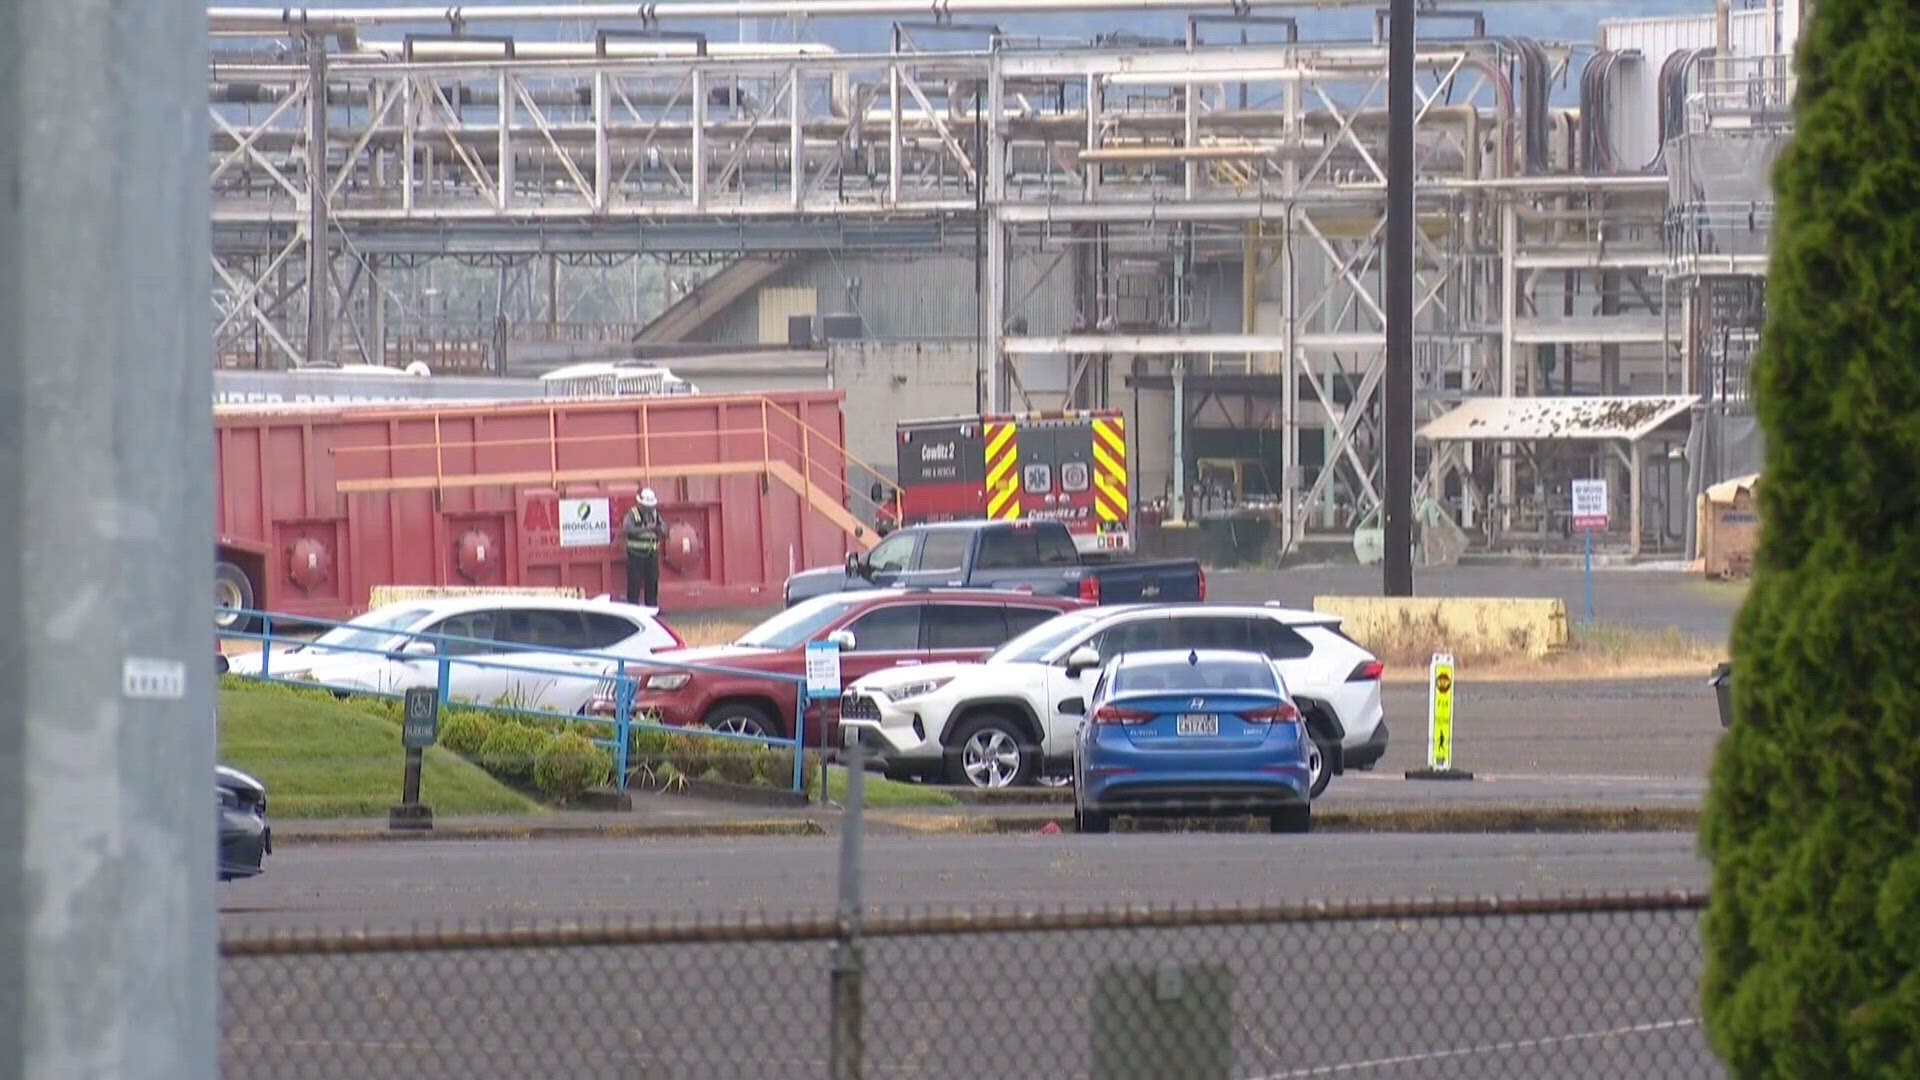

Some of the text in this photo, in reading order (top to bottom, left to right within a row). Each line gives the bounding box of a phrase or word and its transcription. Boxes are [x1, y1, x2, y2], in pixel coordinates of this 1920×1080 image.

[922, 441, 955, 461] Cowlitz 2
[562, 521, 607, 531] IRONCLAD
